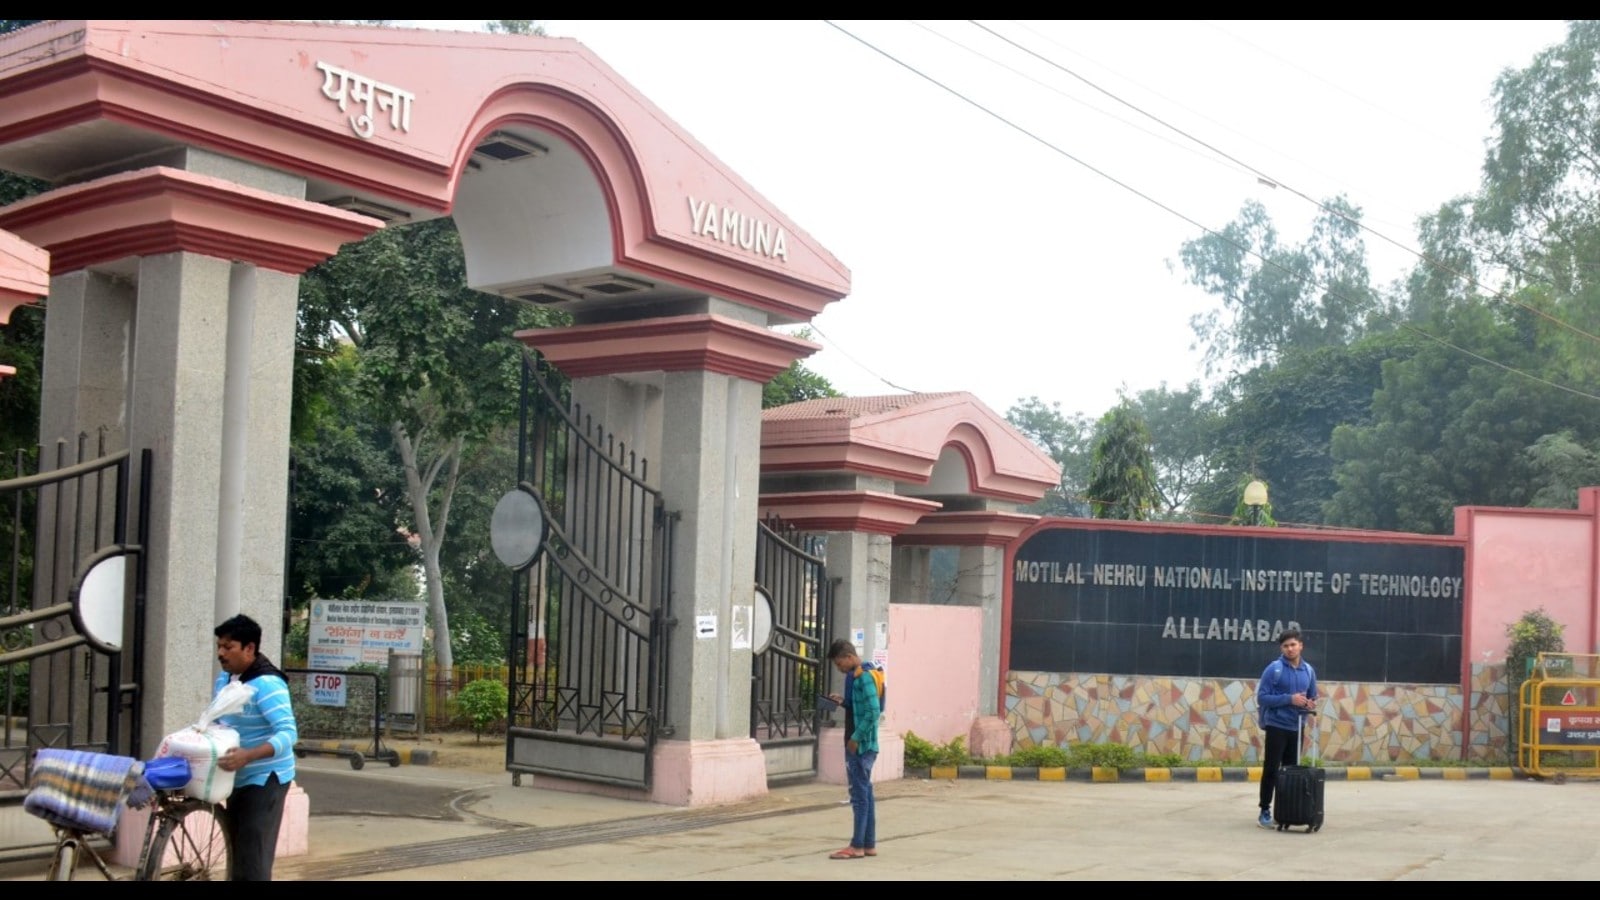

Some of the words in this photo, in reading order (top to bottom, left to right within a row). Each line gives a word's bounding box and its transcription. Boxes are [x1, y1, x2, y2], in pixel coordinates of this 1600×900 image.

[315, 61, 416, 139] यमुना
[687, 195, 788, 263] YAMUNA
[1016, 560, 1085, 585] MOTILAL
[1093, 564, 1147, 587] NEHRU
[1154, 566, 1232, 590] NATIONAL
[1241, 569, 1324, 593] INSTITUTE
[1331, 573, 1351, 594] OF
[1360, 573, 1462, 598] TECHNOLOGY
[314, 675, 341, 690] STOP
